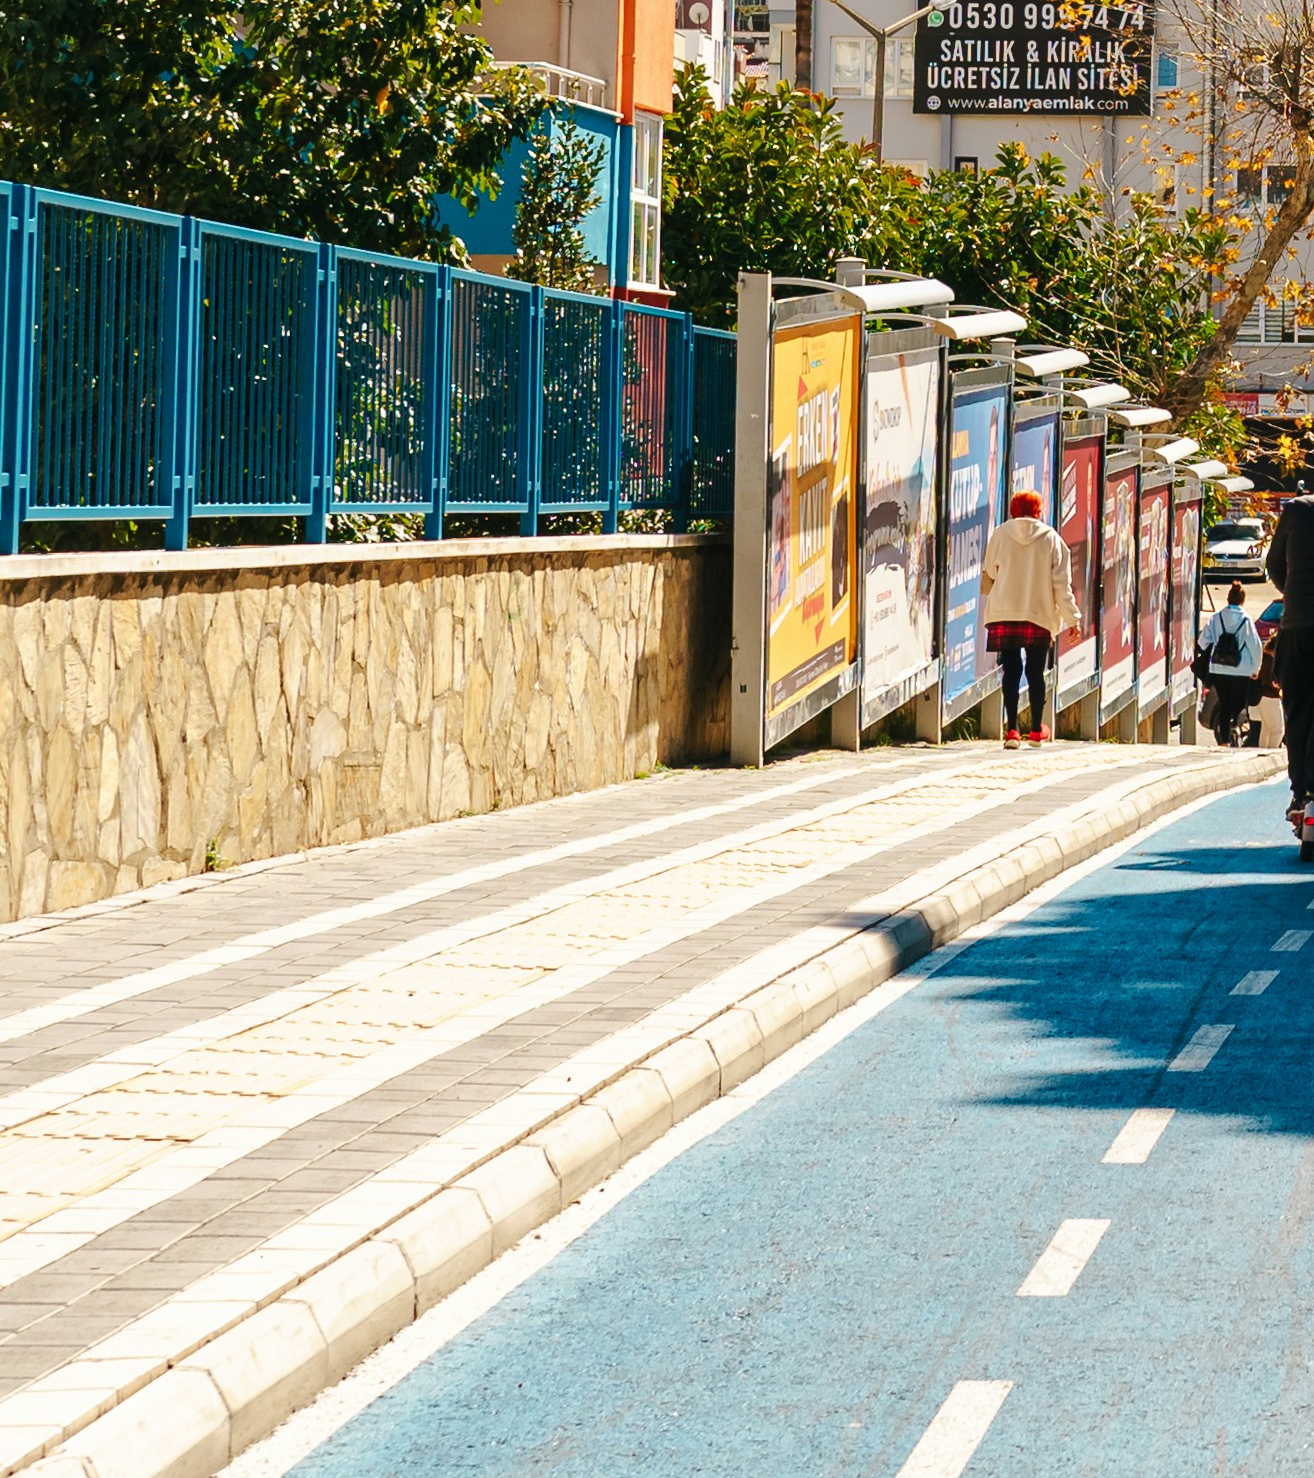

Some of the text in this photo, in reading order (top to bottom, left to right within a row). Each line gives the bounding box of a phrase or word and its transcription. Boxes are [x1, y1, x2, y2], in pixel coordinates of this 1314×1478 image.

[949, 3, 1014, 29] 0530
[940, 36, 1126, 63] SATILIK & KİRALIK
[927, 62, 1139, 90] ÜCRETSİZ İLAN SİTESİ
[948, 95, 1129, 111] www.alanyaemlak.com
